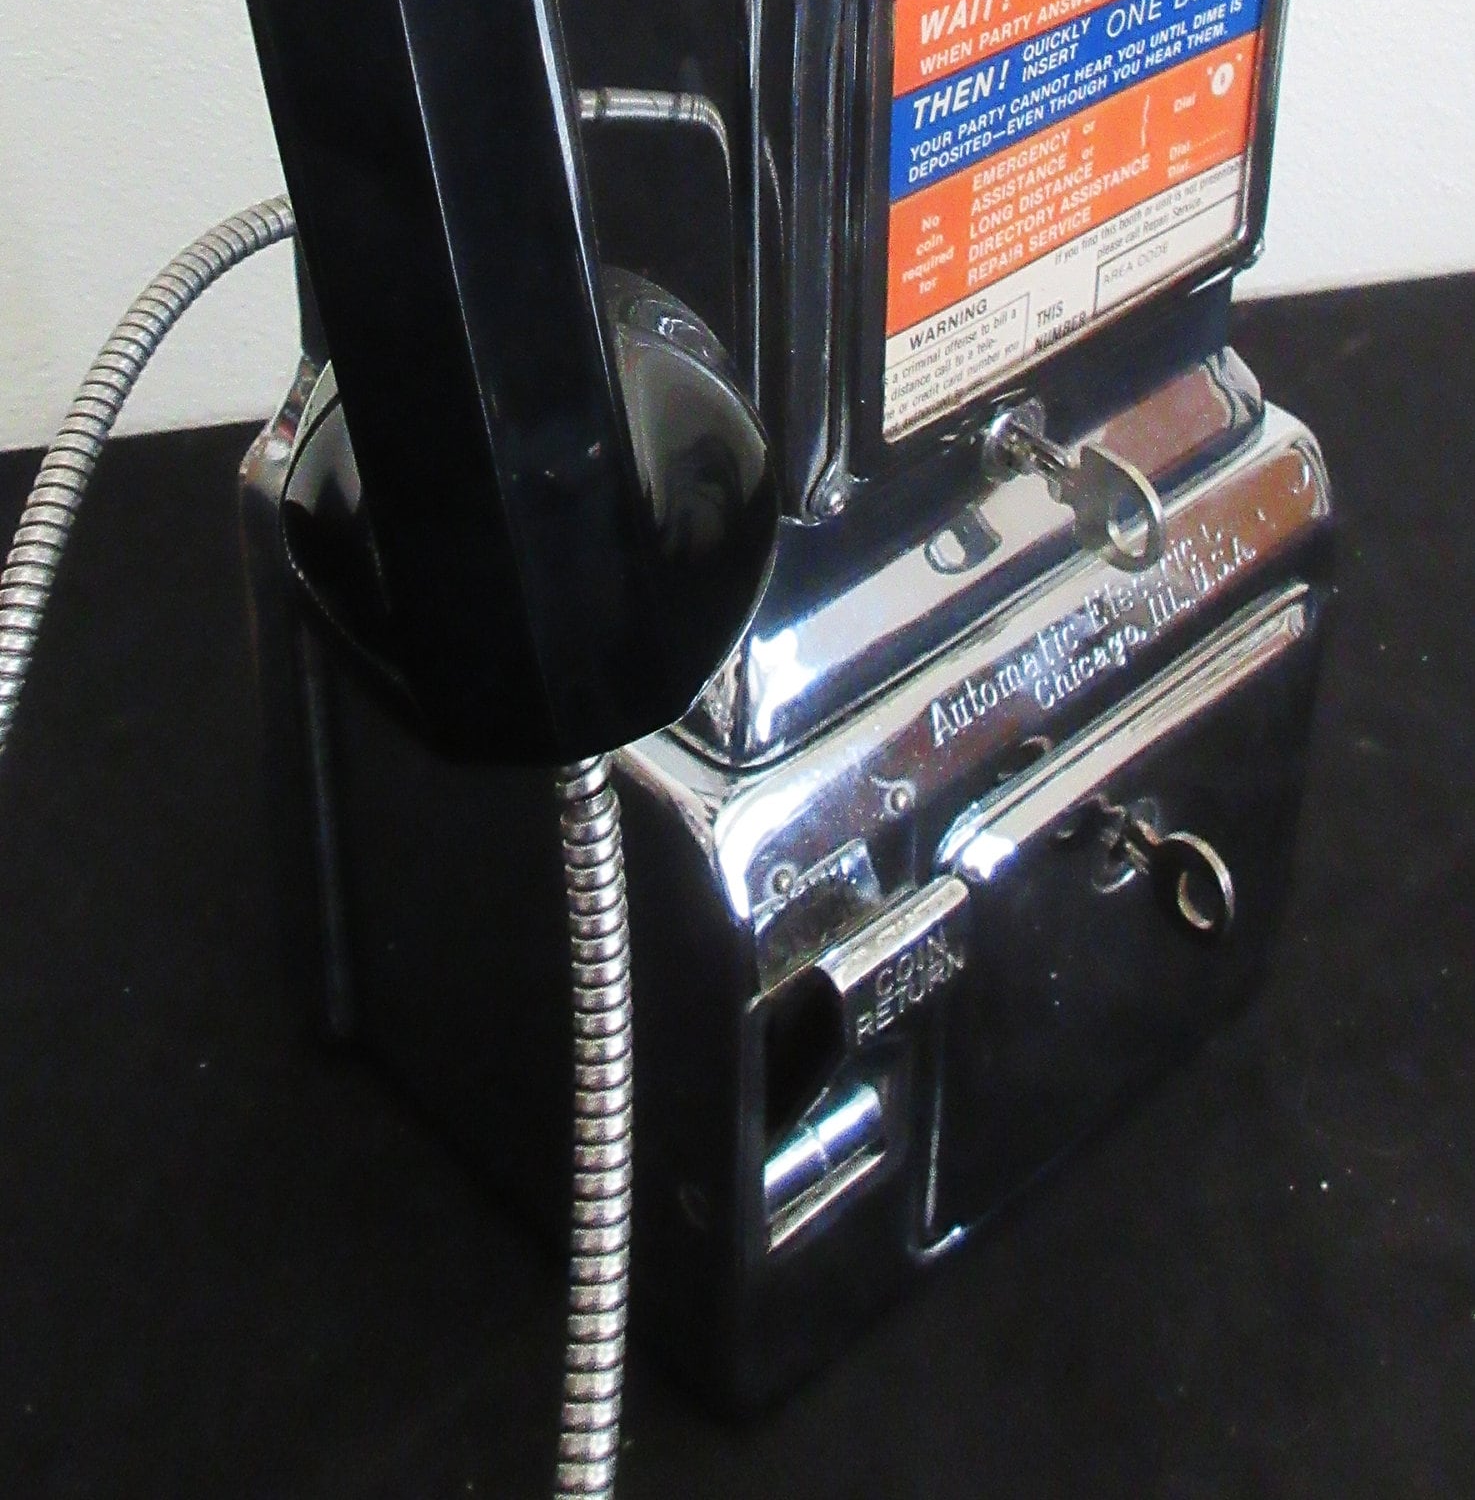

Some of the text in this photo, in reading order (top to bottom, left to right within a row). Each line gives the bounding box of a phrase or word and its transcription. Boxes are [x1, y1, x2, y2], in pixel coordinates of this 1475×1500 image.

[919, 38, 973, 77] WHEN
[979, 11, 1035, 51] PARTY
[1021, 16, 1092, 62] QUICKLY
[1021, 42, 1080, 84] INSERT
[1049, 75, 1108, 115] THOUGH
[1113, 58, 1141, 84] YOU
[1144, 40, 1182, 70] HEAR
[1187, 21, 1229, 51] THEM.
[909, 130, 953, 162] YOUR
[958, 103, 1007, 140] PARTY
[1010, 73, 1071, 115] CANNOT
[1074, 54, 1113, 84] HEAR
[1118, 39, 1146, 63] YOU
[1150, 20, 1188, 48] UNTIL
[1193, 2, 1227, 31] DIME
[970, 152, 1069, 217] ASSISTANCE
[972, 120, 1097, 192] EMERGENCY or
[920, 213, 941, 233] No
[968, 153, 1151, 263] DIRECTORY ASSISTANCE
[969, 161, 1095, 240] LONG DISTANCE
[901, 245, 956, 284] required
[915, 232, 944, 257] coin
[967, 205, 1093, 288] REPAIR SERVICE
[1104, 261, 1134, 286] AREA
[918, 277, 938, 295] for
[1035, 299, 1065, 328] THIS
[901, 344, 941, 379] criminal
[943, 329, 979, 357] offense
[980, 322, 991, 337] to
[993, 310, 1009, 329] bill
[909, 298, 988, 350] WARNING
[1033, 310, 1088, 350] NUMBER
[928, 619, 1079, 748] Automatic
